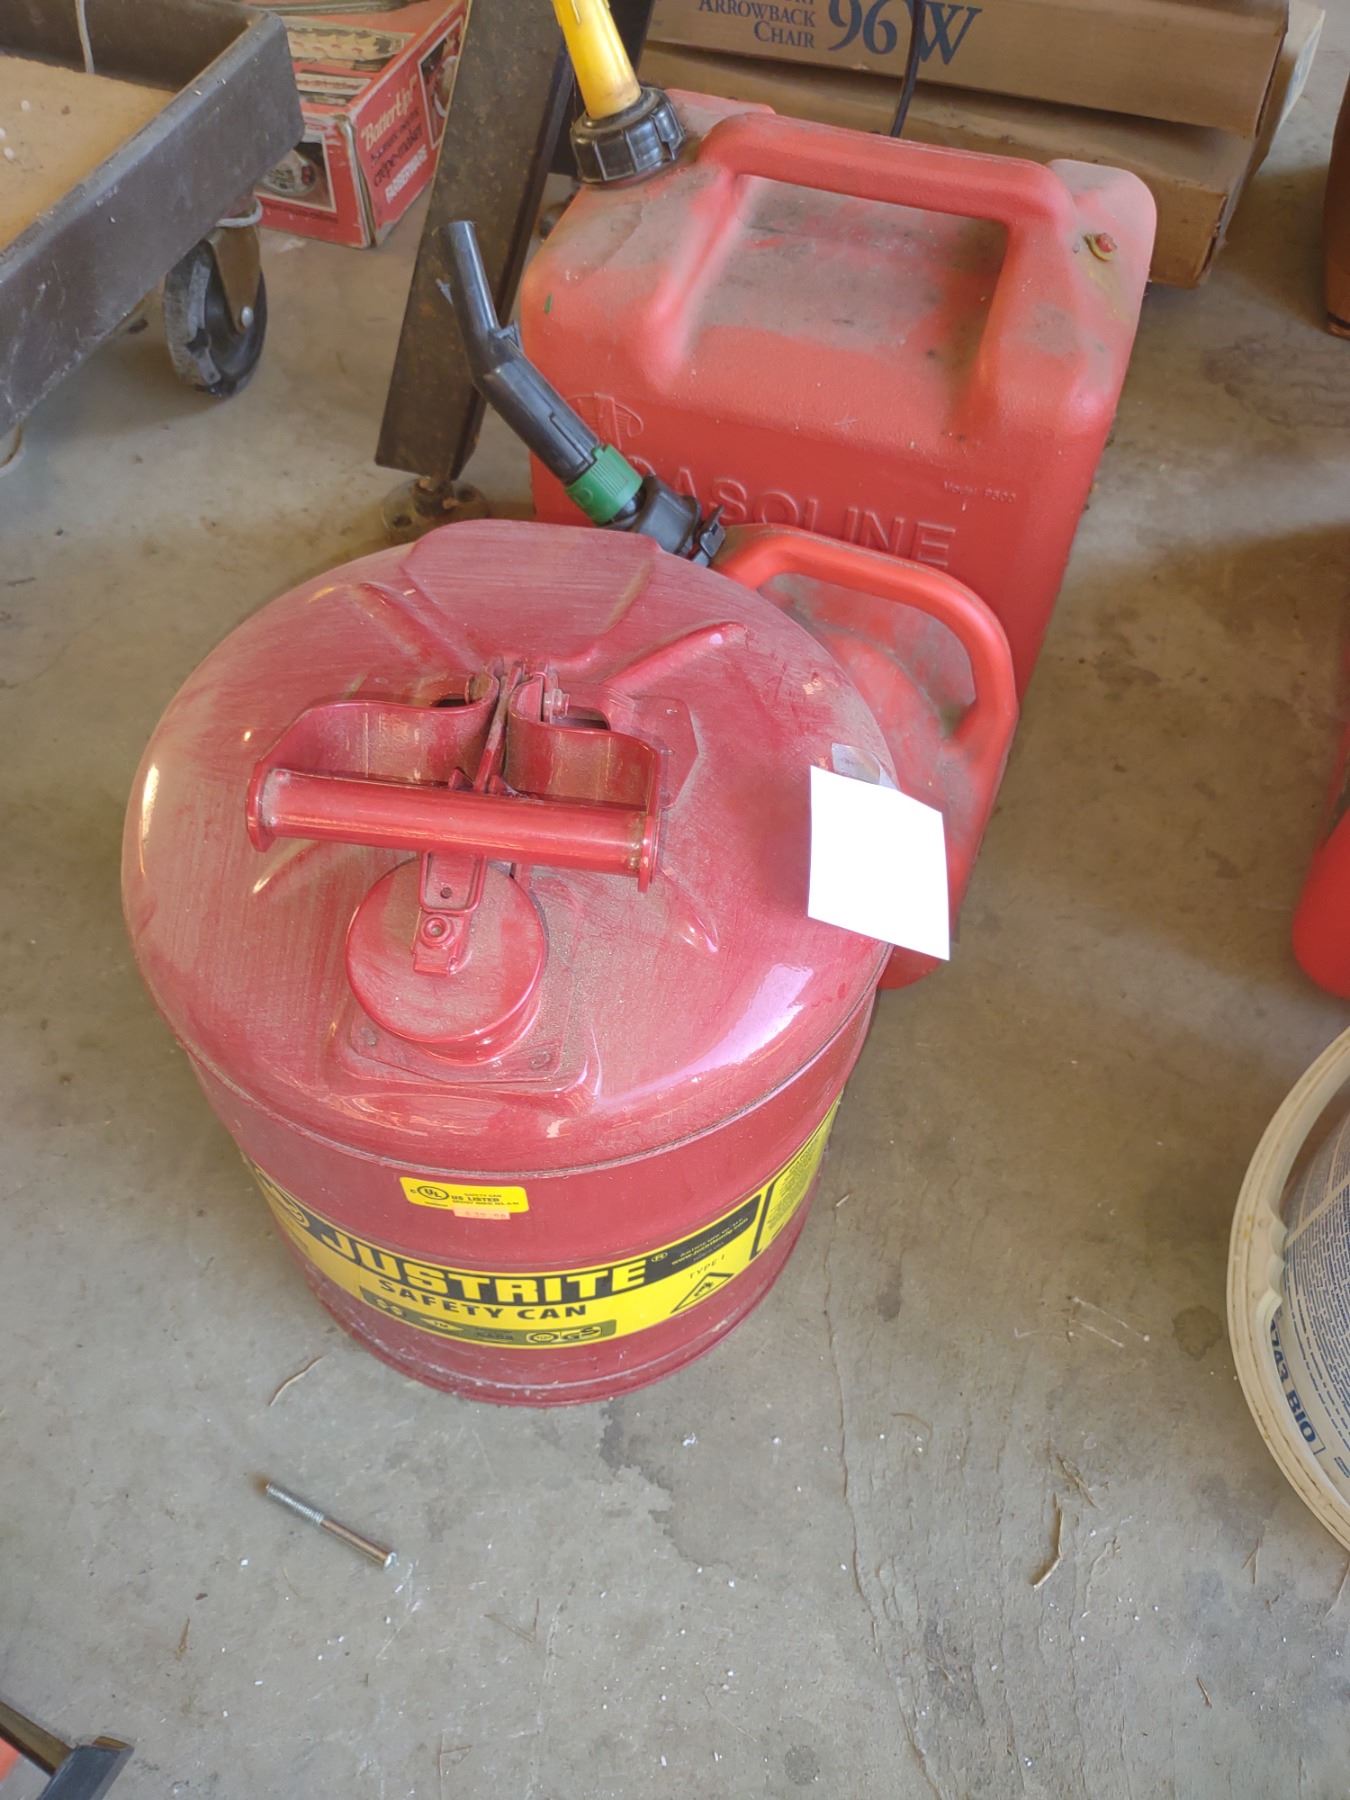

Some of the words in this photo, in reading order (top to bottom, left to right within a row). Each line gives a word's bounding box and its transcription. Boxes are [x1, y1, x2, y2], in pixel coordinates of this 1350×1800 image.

[697, 0, 816, 27] ARROWBACK
[754, 20, 815, 49] CHAIR
[320, 1231, 647, 1304] JUSTRITE
[379, 1279, 504, 1319] SAFETY
[517, 1304, 588, 1320] CAN
[1286, 1389, 1317, 1443] BIO
